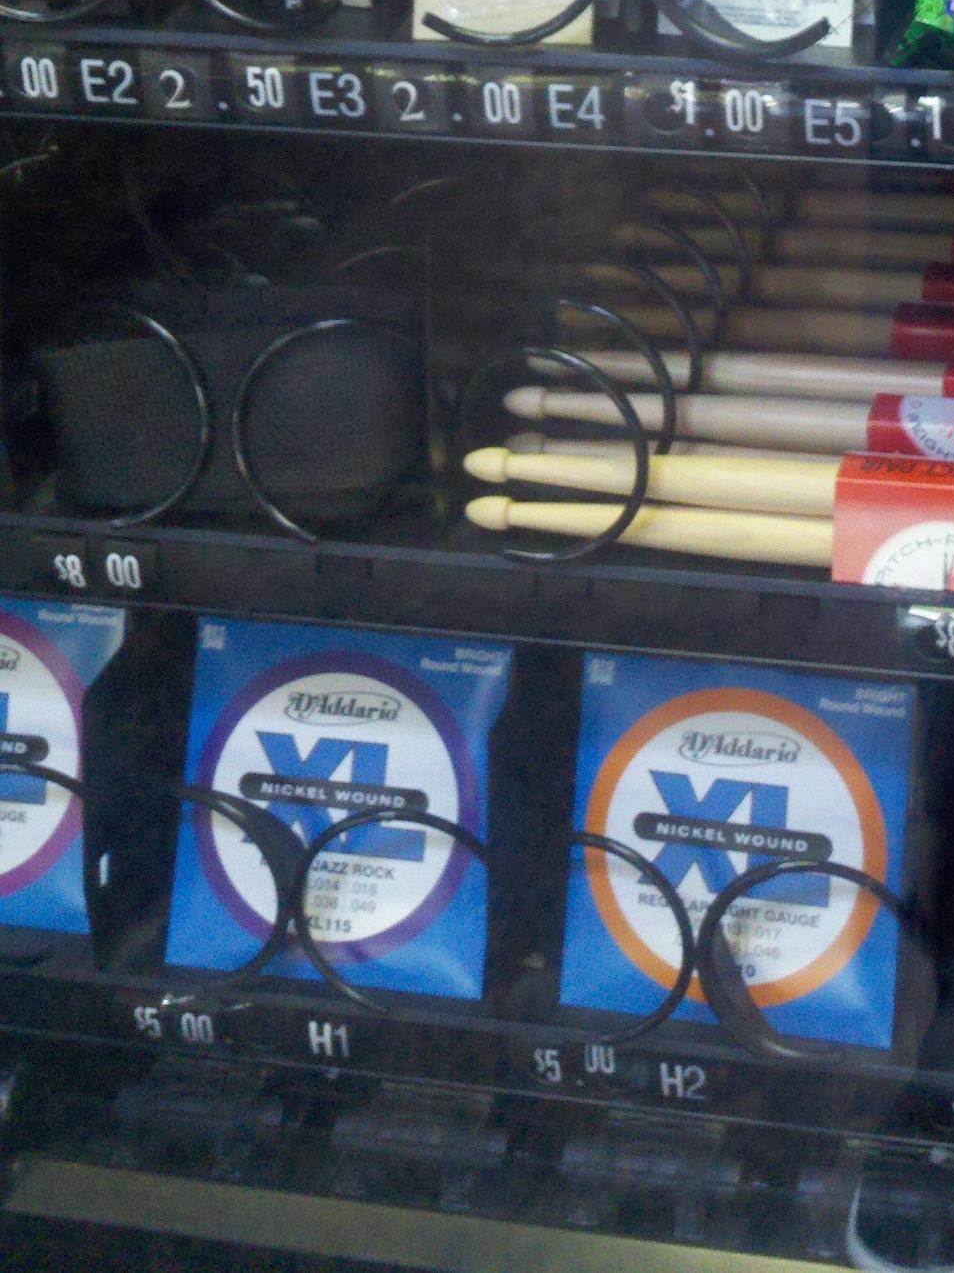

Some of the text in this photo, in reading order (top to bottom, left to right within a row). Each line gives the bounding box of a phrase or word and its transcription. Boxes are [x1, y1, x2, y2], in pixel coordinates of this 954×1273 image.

[80, 58, 139, 107] E2
[308, 71, 368, 119] E3
[547, 83, 607, 131] E4
[803, 97, 863, 148] E5
[260, 780, 407, 810] NICKEL WOUND
[655, 820, 809, 853] NICKEL WOUND
[308, 1020, 351, 1058] H1
[659, 1061, 708, 1100] H2
